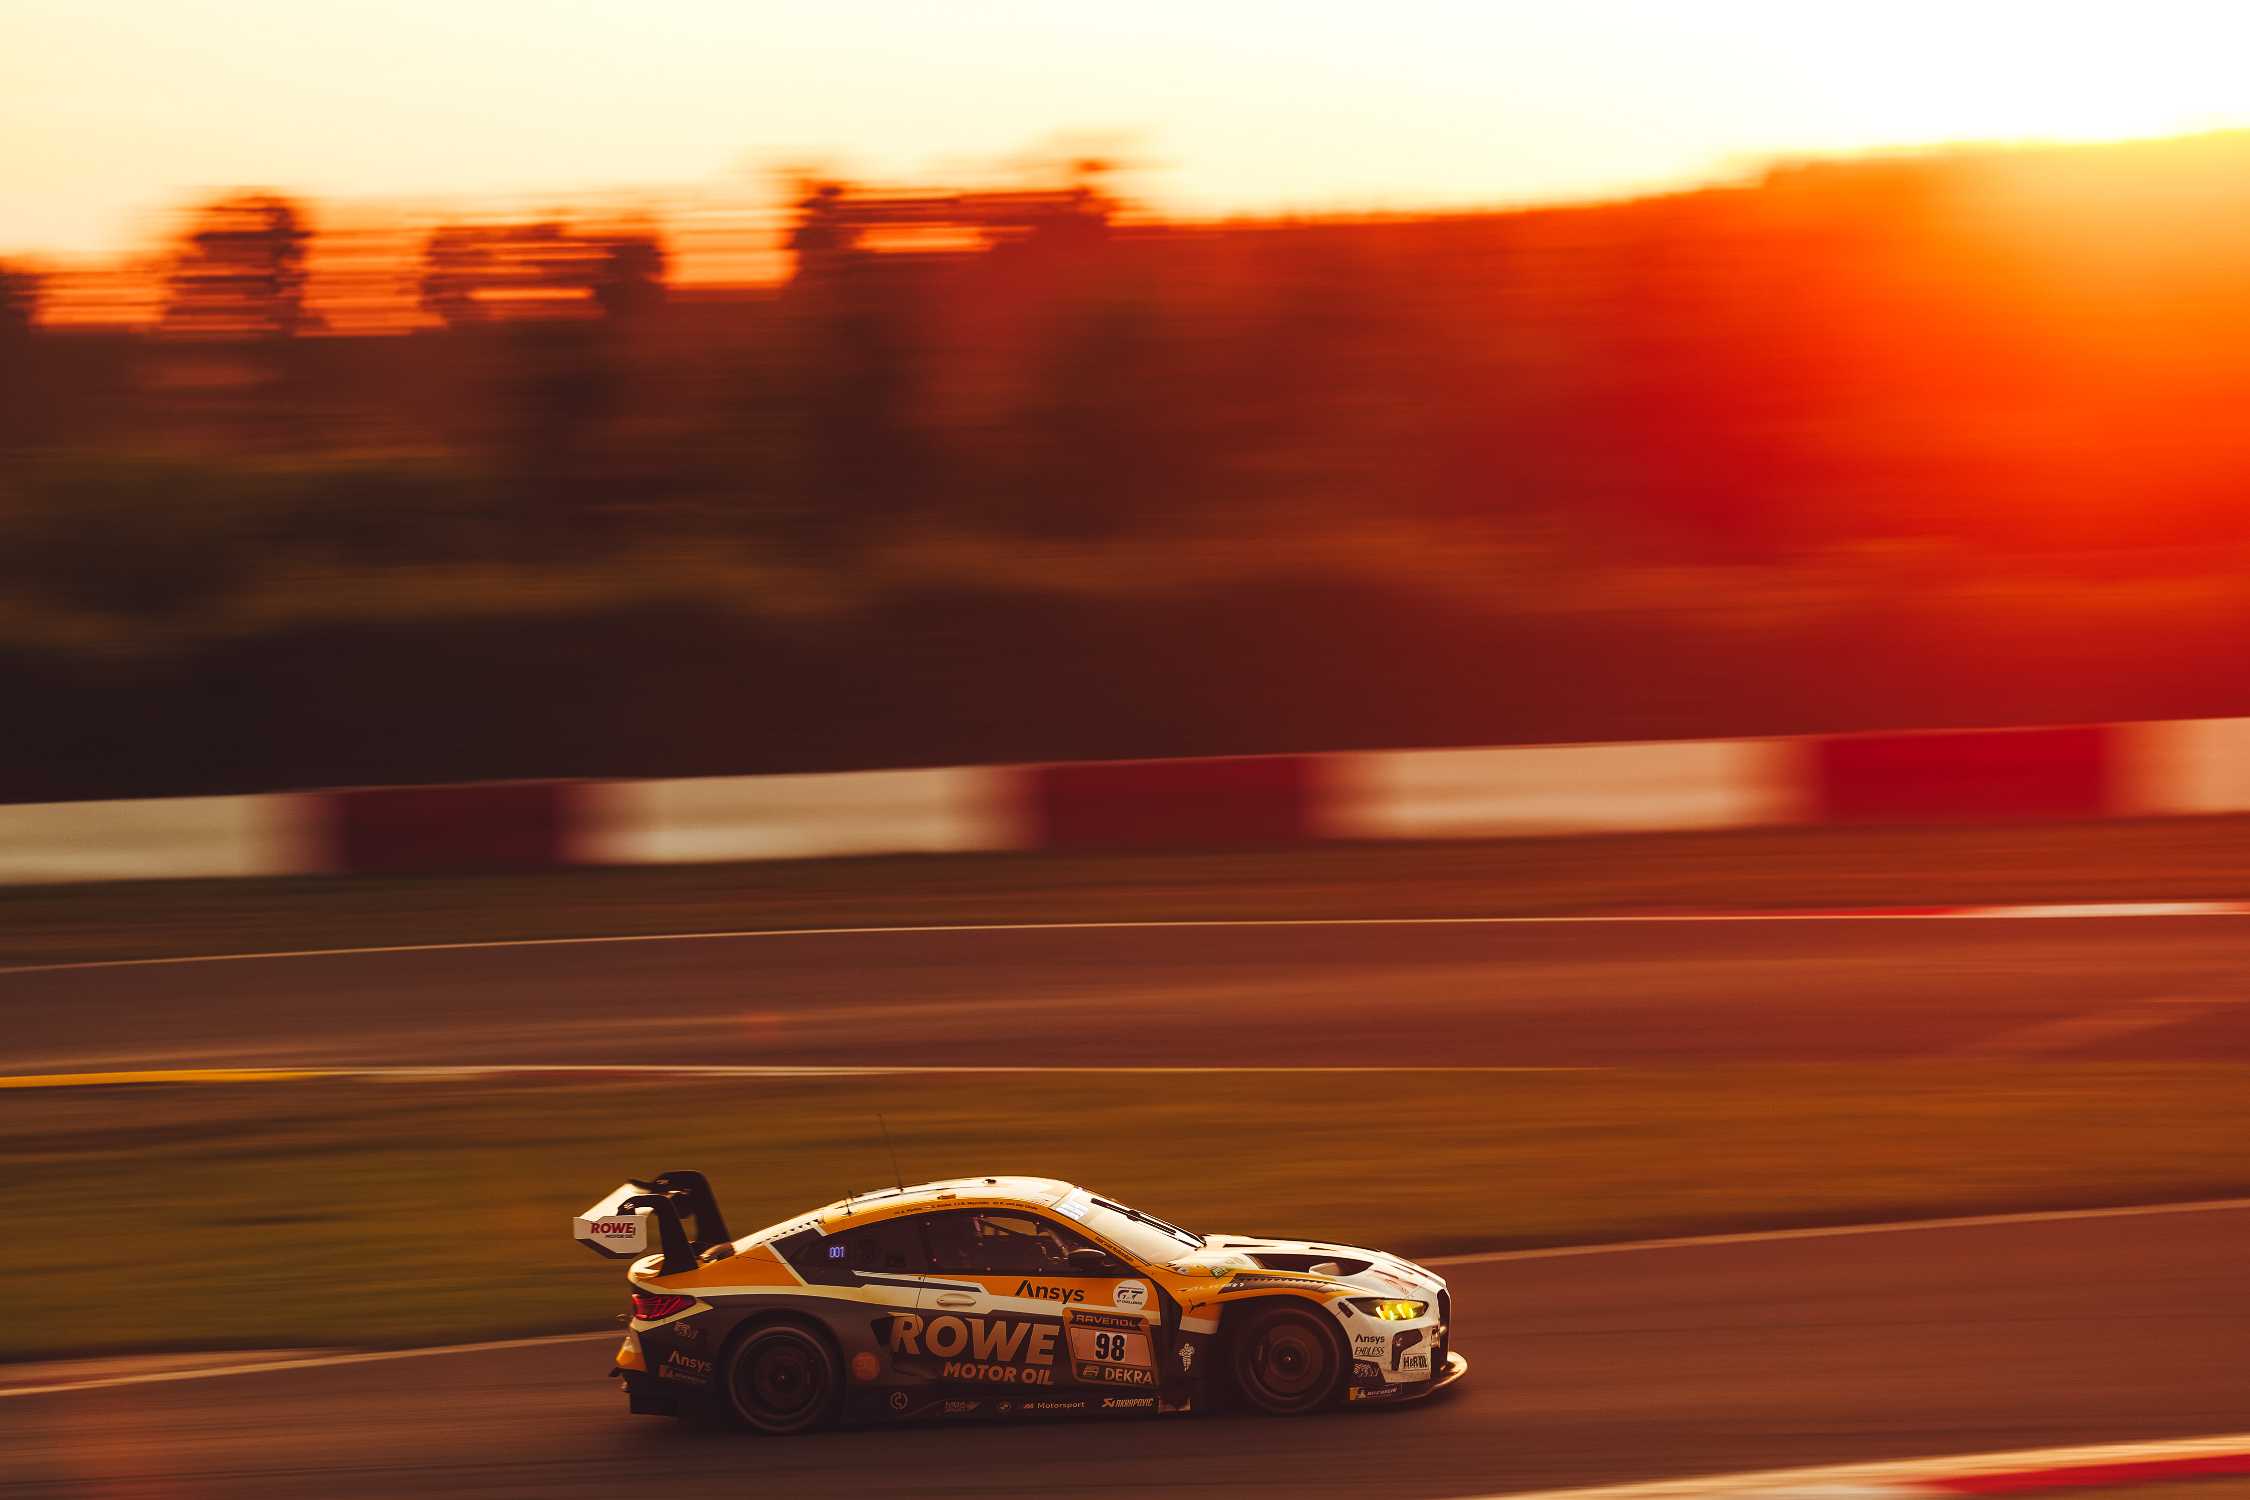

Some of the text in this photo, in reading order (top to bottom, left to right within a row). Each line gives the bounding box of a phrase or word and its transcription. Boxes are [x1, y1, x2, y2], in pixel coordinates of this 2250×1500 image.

[590, 1222, 634, 1234] ROWE
[1014, 1279, 1085, 1305] Ansys
[1075, 1314, 1139, 1327] RAVENOL
[888, 1311, 1060, 1365] ROWE
[1354, 1333, 1385, 1344] Ansys
[1095, 1333, 1125, 1361] 98
[1354, 1346, 1385, 1356] ENDLESS
[668, 1350, 712, 1373] Ansys
[943, 1361, 1054, 1386] MOTOR OIL
[1104, 1367, 1153, 1384] DEKRA
[1037, 1400, 1086, 1411] Motorsport
